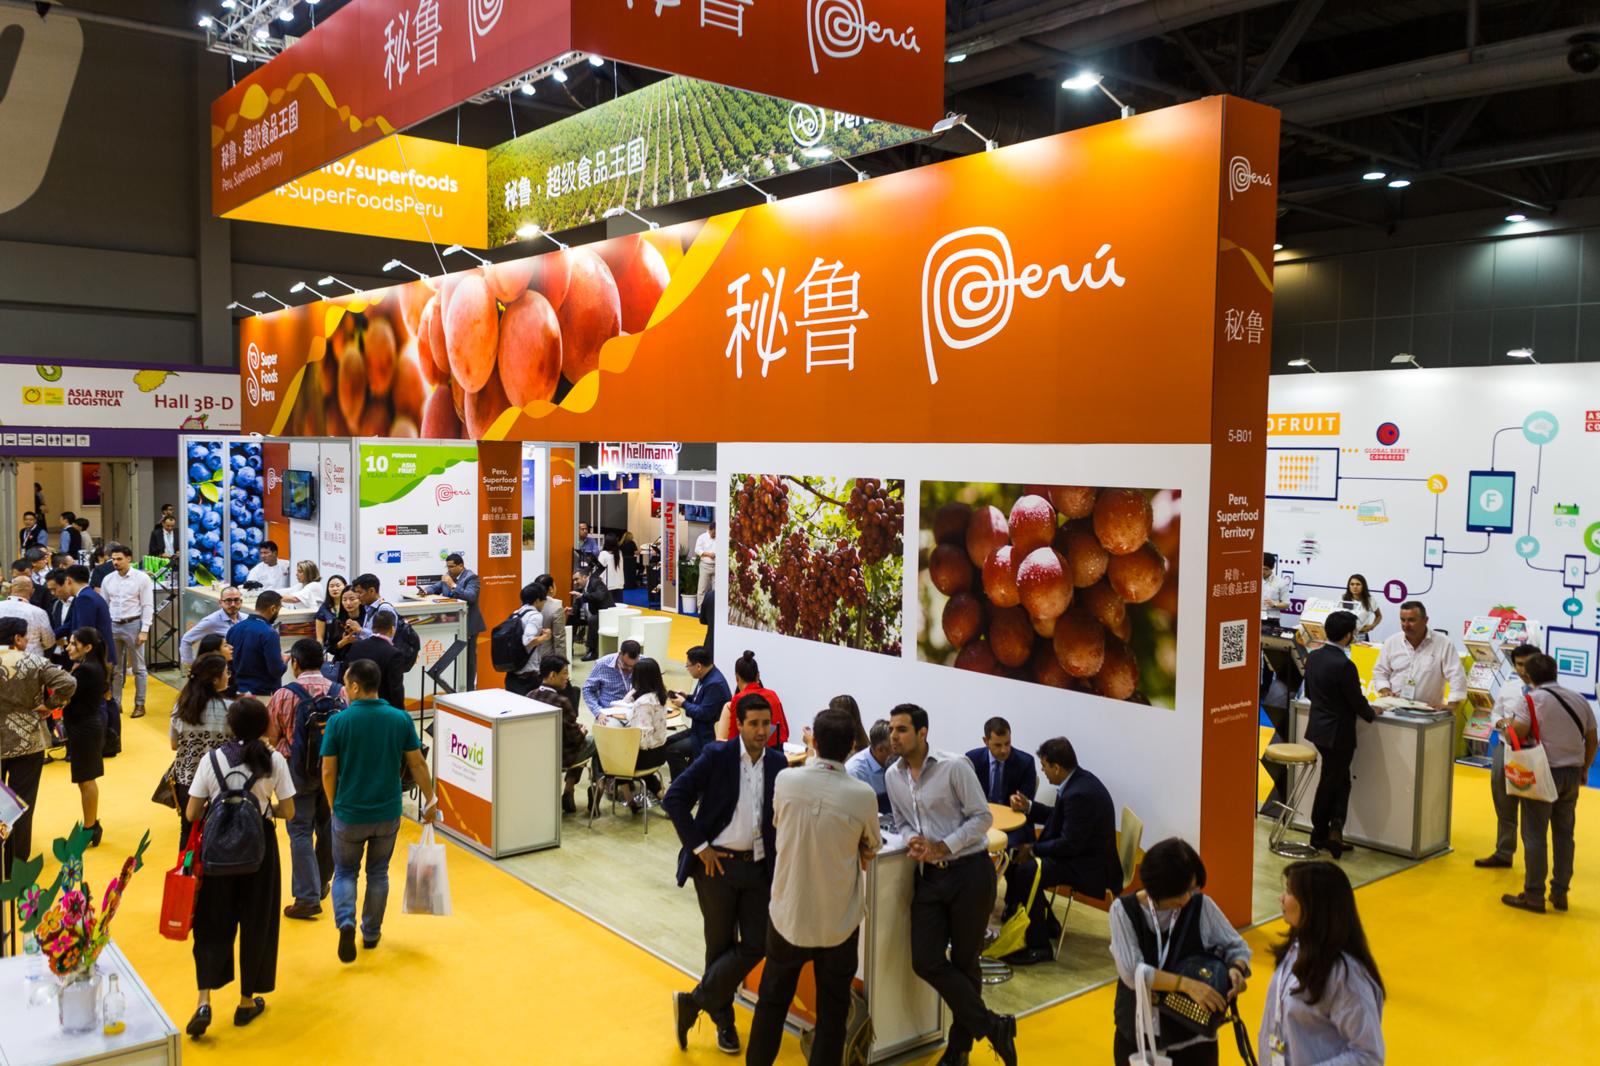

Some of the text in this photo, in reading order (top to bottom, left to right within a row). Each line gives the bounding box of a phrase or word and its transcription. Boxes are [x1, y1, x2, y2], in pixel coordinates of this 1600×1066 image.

[384, 0, 442, 91] 秘鲁
[1228, 155, 1272, 201] Perú
[921, 226, 1126, 385] Perú
[725, 256, 869, 379] 秘鲁
[1224, 307, 1265, 344] 秘鲁
[261, 352, 278, 369] Super
[261, 369, 279, 384] Foods
[67, 388, 93, 398] ASIA
[95, 389, 124, 399] FRUIT
[67, 397, 121, 407] LOGISTICA
[261, 387, 275, 402] Peru
[154, 394, 234, 413] Hall 3B-D
[1228, 429, 1252, 442] 5-B01
[627, 443, 674, 460] hellmann
[365, 455, 389, 473] 10
[482, 475, 518, 485] Superfood
[486, 484, 515, 493] Territory
[1228, 493, 1249, 507] Peru,
[1216, 508, 1260, 525] Superfood
[1219, 526, 1256, 540] Territory
[450, 733, 484, 766] Provid
